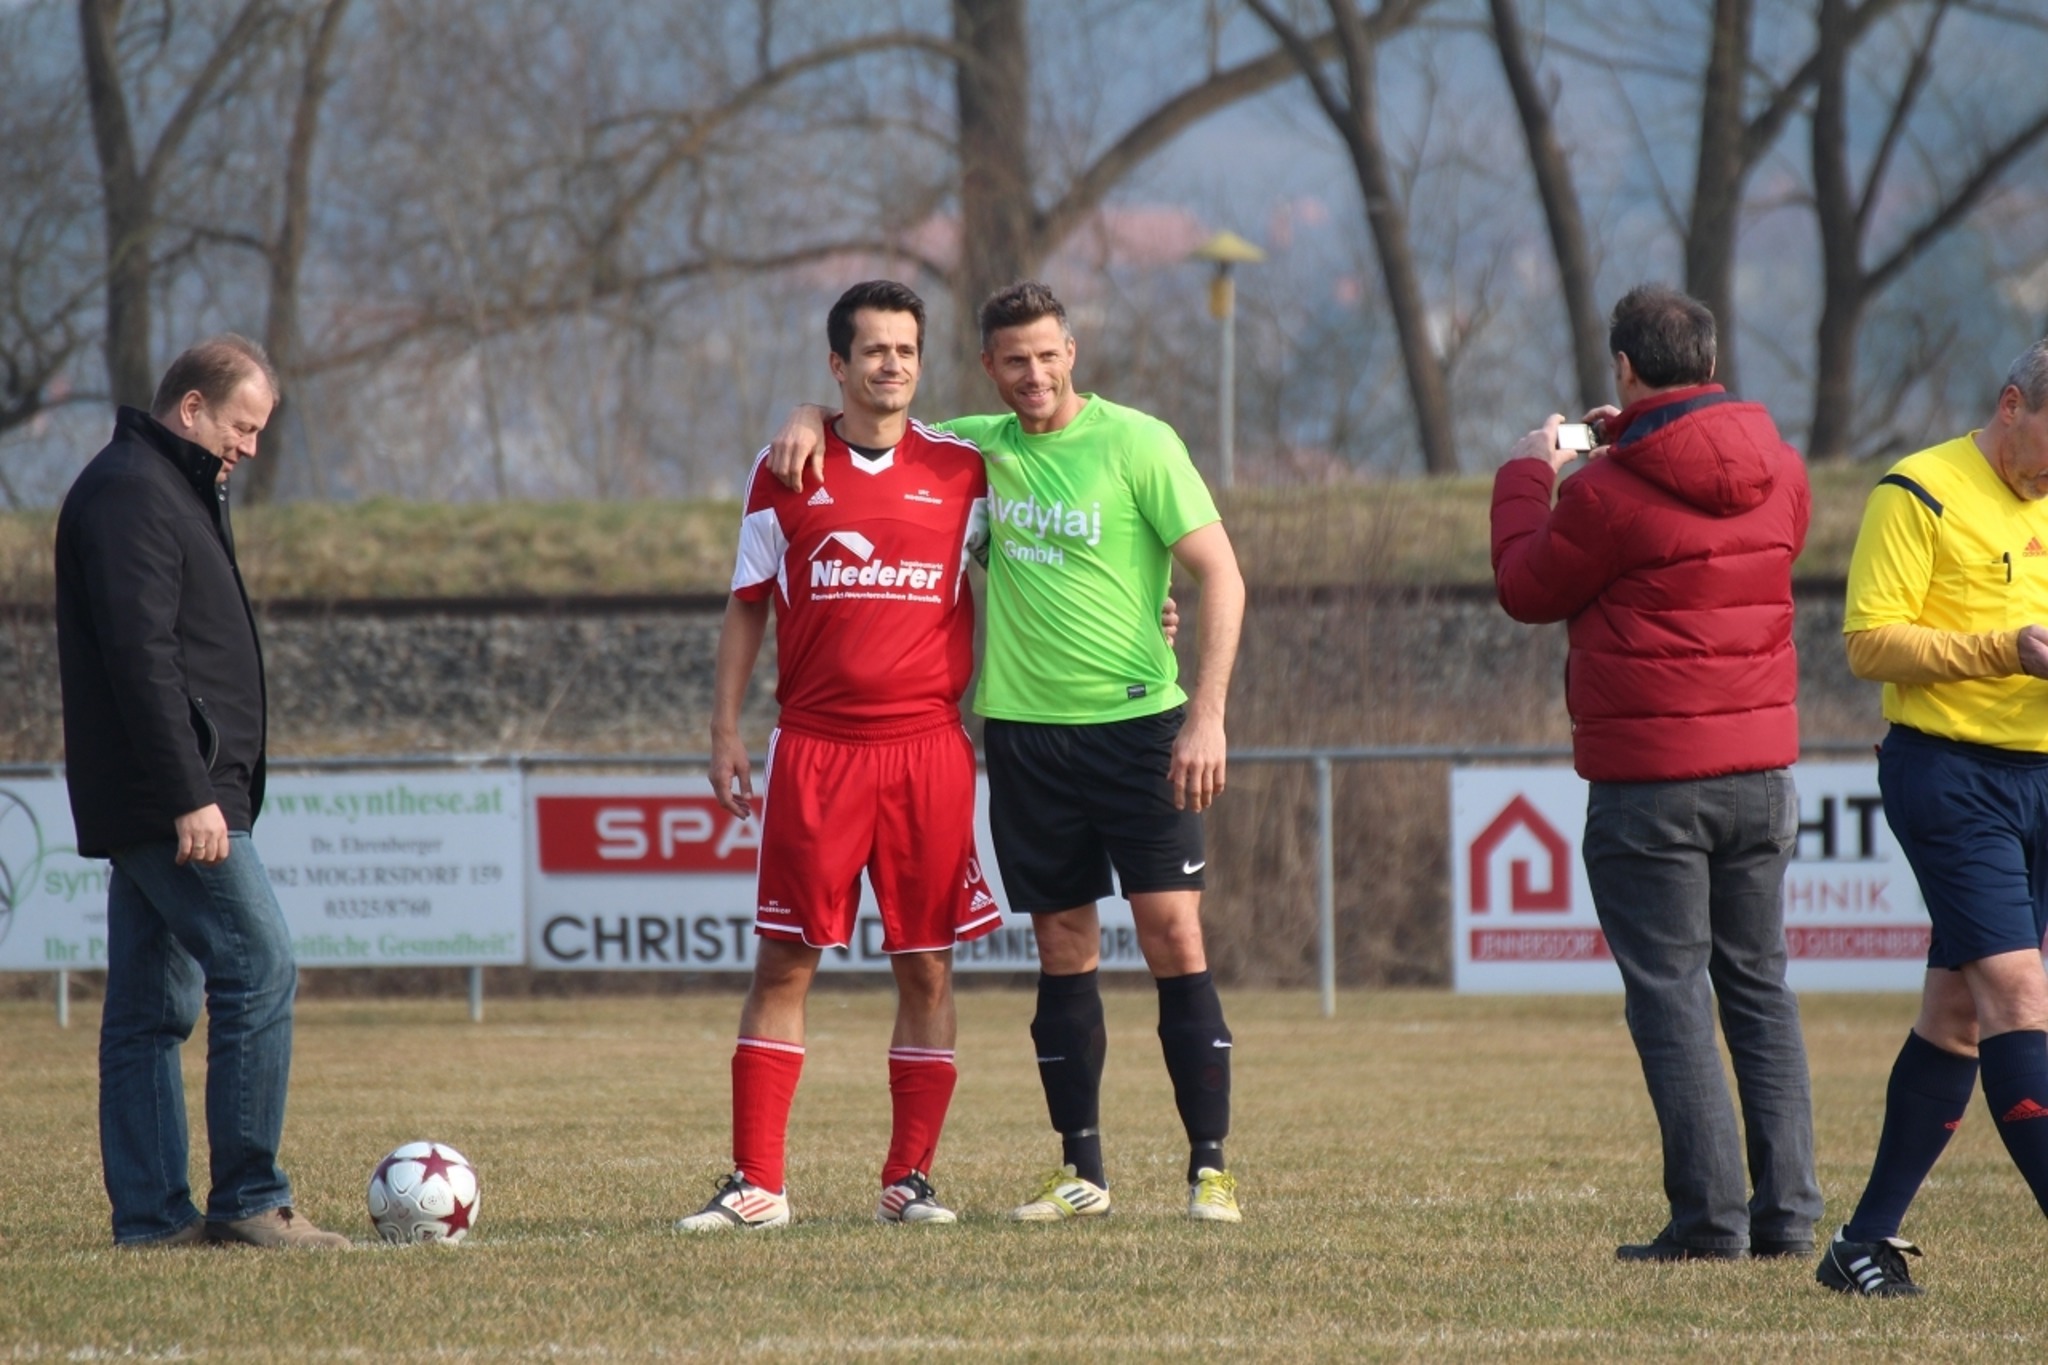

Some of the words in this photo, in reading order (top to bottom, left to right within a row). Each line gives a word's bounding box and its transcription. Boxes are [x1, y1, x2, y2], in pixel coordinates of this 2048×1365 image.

[1004, 540, 1064, 566] GmbH
[811, 559, 943, 590] Niederer
[595, 808, 762, 860] SPA
[1793, 797, 1885, 859] HT
[304, 867, 462, 886] MOGERSDORF
[1789, 878, 1893, 912] HNIK
